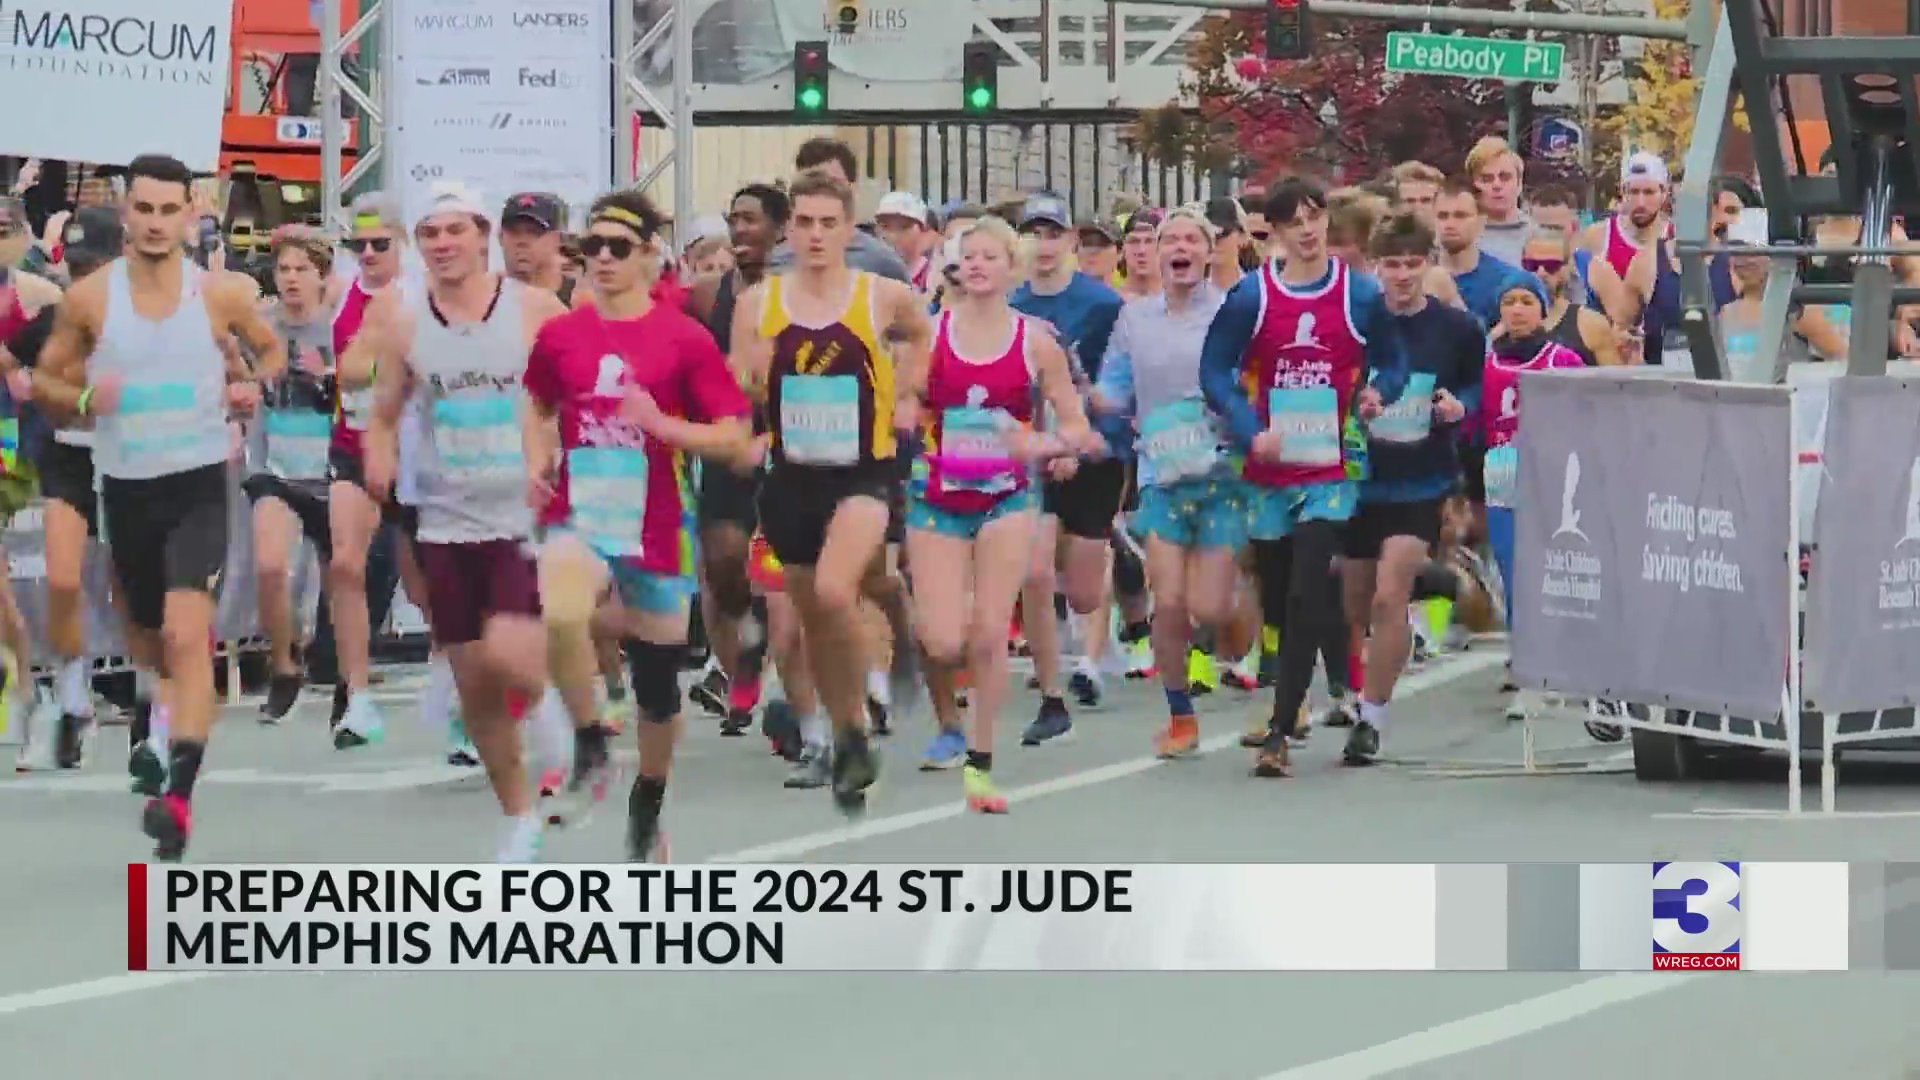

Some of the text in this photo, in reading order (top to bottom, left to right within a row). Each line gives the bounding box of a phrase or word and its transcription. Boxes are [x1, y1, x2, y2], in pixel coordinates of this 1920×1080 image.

[13, 9, 216, 63] MARCUM
[513, 11, 590, 29] LANDERS
[10, 54, 213, 86] FOUNDATION
[1395, 36, 1555, 77] Peabody Pl.
[1274, 371, 1331, 391] HERO
